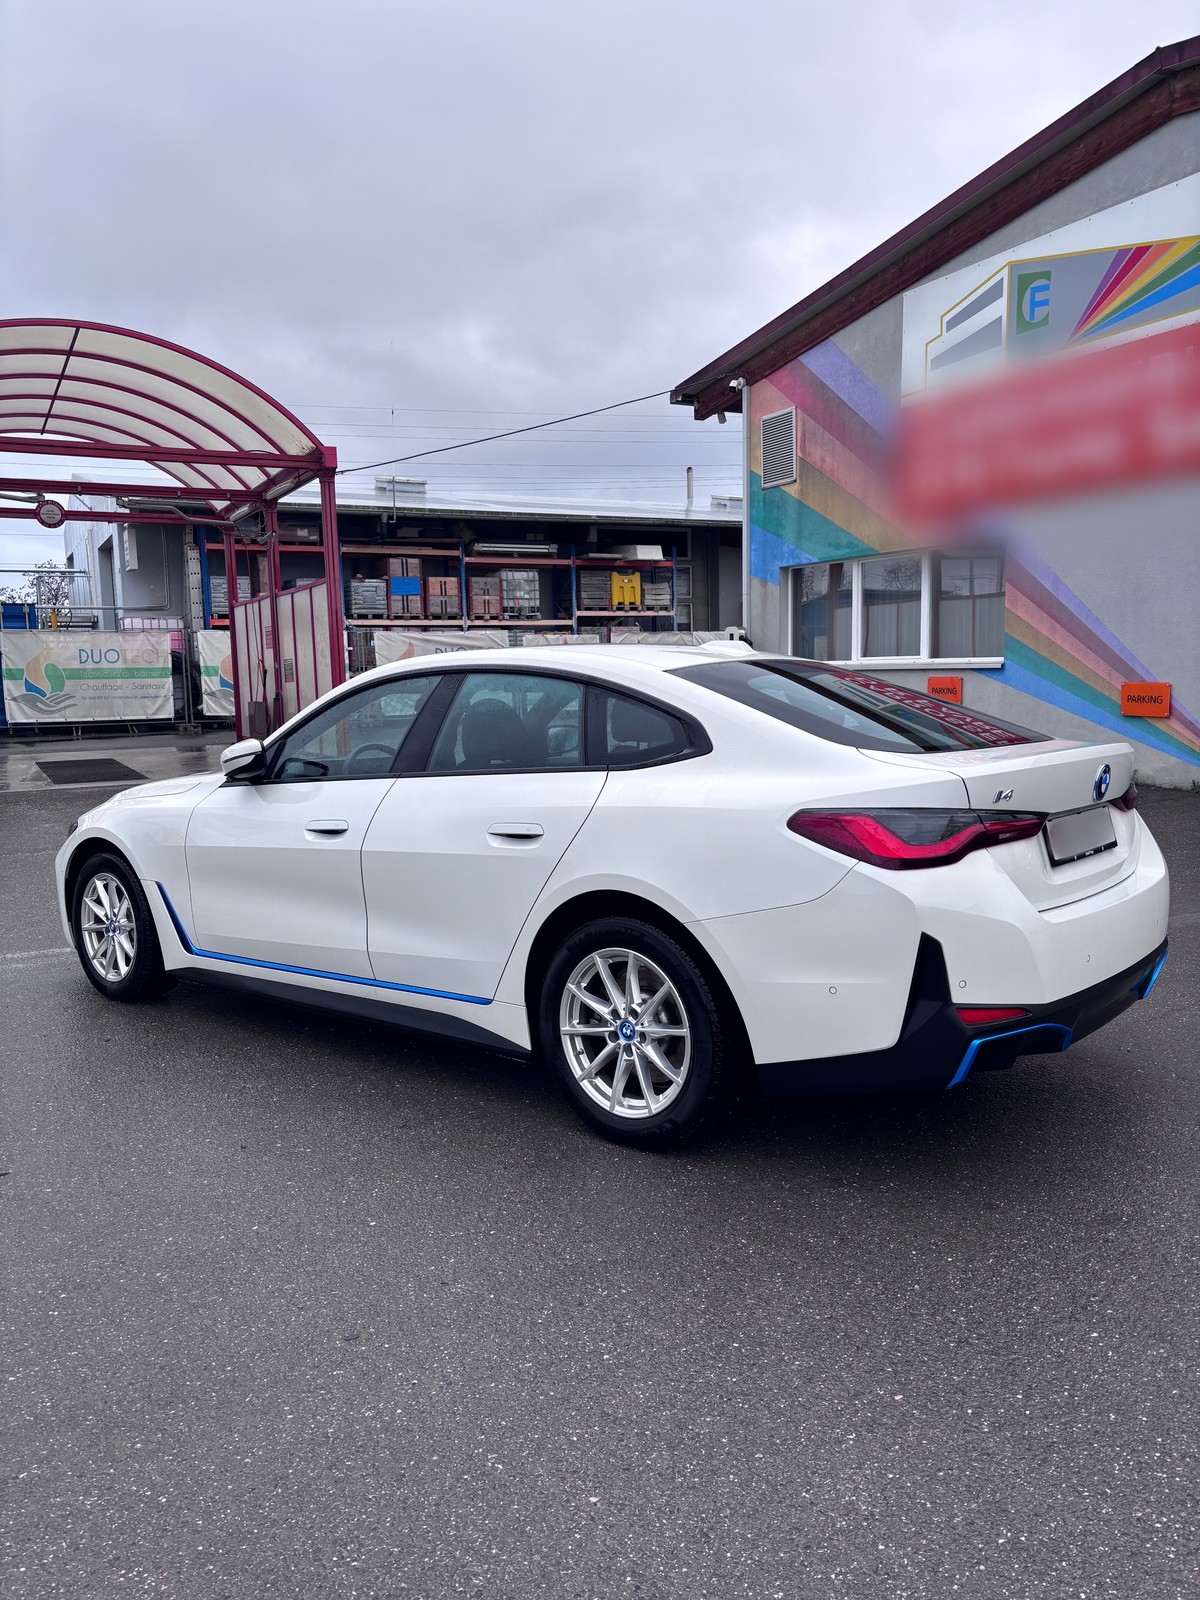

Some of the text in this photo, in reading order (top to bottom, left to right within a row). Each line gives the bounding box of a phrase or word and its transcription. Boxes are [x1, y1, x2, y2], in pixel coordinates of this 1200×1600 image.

[78, 648, 166, 664] DUOTECH
[80, 669, 120, 679] Techniques
[80, 682, 123, 691] Chauffage
[132, 682, 166, 691] Sanitaire
[931, 687, 957, 695] PARKING
[1126, 695, 1163, 704] PARKING
[992, 789, 1014, 804] i4
